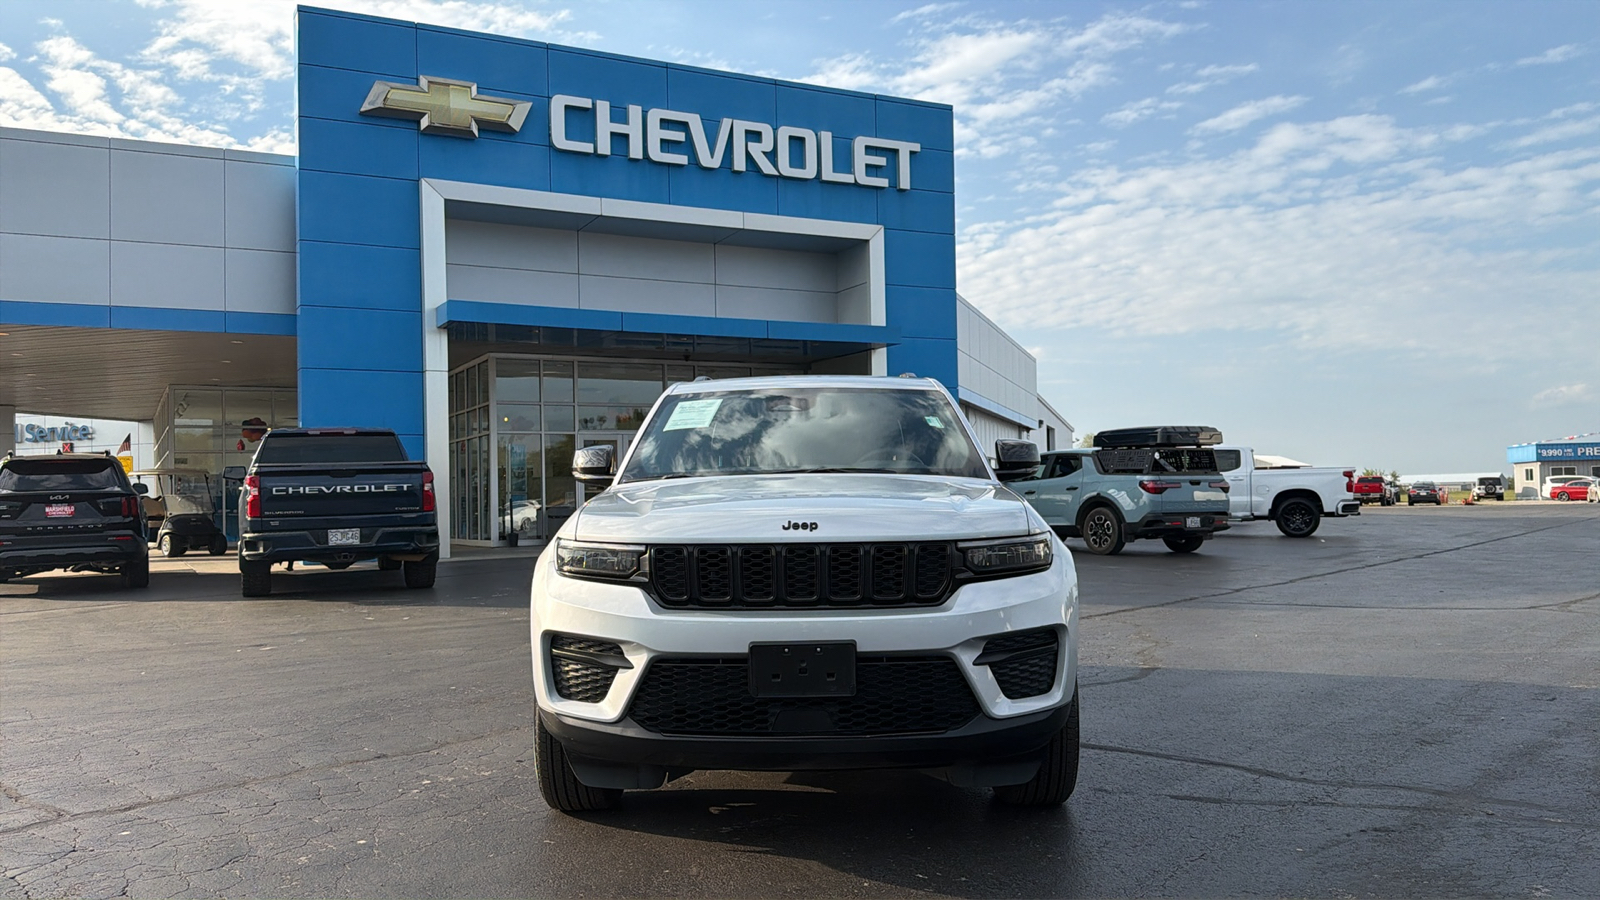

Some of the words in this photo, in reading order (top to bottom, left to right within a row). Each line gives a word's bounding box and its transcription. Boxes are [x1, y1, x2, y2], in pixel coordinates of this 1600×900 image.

[550, 94, 921, 190] CHEVROLET
[25, 421, 91, 443] Service
[272, 483, 412, 495] CHEVROLET
[45, 505, 75, 513] MARSHFIELD
[782, 520, 818, 532] Jeep
